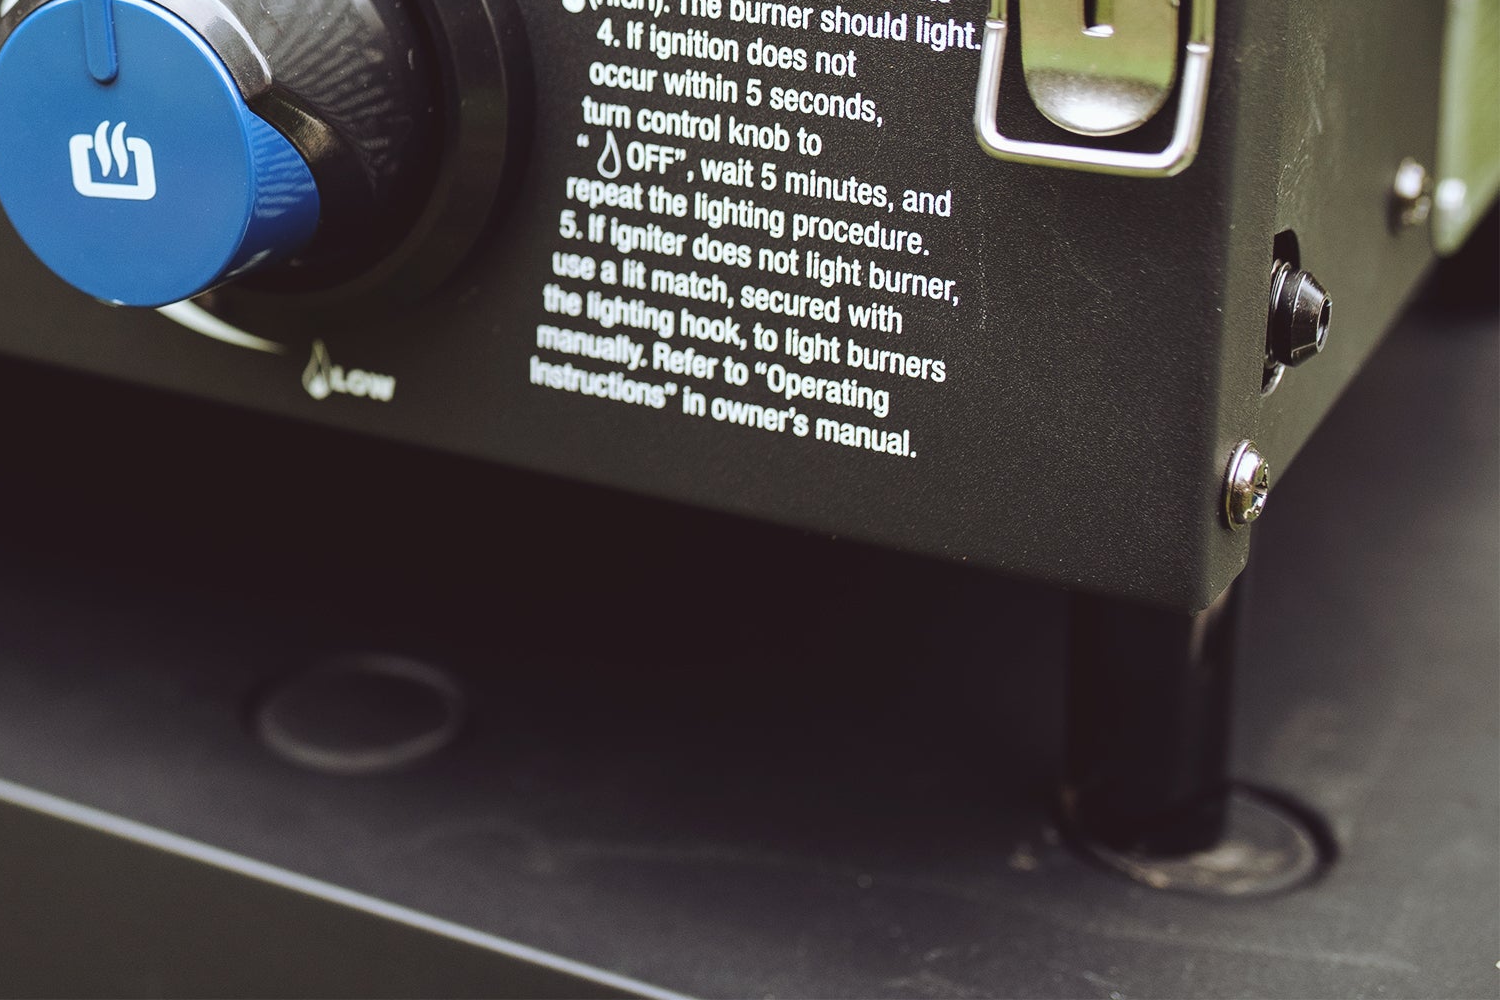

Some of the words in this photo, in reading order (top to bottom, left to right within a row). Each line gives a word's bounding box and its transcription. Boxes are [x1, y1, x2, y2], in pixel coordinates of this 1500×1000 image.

[596, 17, 621, 48] 4.
[626, 20, 645, 51] If
[649, 23, 740, 63] ignition
[746, 37, 808, 72] does
[815, 49, 858, 79] not
[820, 4, 908, 42] should
[915, 14, 984, 53] light.
[581, 95, 632, 130] turn
[636, 108, 722, 143] control
[728, 115, 790, 152] knob
[796, 126, 823, 157] to
[589, 61, 659, 93] occur
[662, 68, 738, 104] within
[745, 78, 763, 107] 5
[769, 86, 883, 128] seconds,
[566, 176, 644, 211] repeat
[647, 184, 688, 218] the
[694, 191, 786, 239] lighting
[792, 213, 930, 256] procedure.
[700, 157, 755, 188] wait
[760, 162, 778, 191] 5
[784, 168, 894, 214] minutes,
[901, 189, 952, 218] and
[559, 209, 583, 240] 5.
[588, 213, 607, 244] If
[610, 216, 688, 257] igniter
[692, 232, 752, 269] does
[758, 247, 800, 277] not
[805, 250, 862, 288] light
[868, 260, 959, 307] burner,
[552, 251, 597, 281] use
[599, 260, 618, 285] a
[622, 258, 647, 290] lit
[651, 269, 735, 310] match,
[740, 285, 841, 324] secured
[847, 302, 903, 335] with
[536, 324, 648, 371] manually.
[652, 341, 720, 380] Refer
[722, 355, 749, 387] to
[542, 283, 583, 317] the
[586, 290, 675, 339] lighting
[680, 307, 748, 351] hook,
[752, 322, 779, 353] to
[784, 326, 841, 365] light
[846, 338, 947, 383] burners
[330, 365, 396, 402] LOW
[682, 385, 707, 417] in
[710, 397, 810, 437] owner’s
[815, 417, 917, 459] manual.
